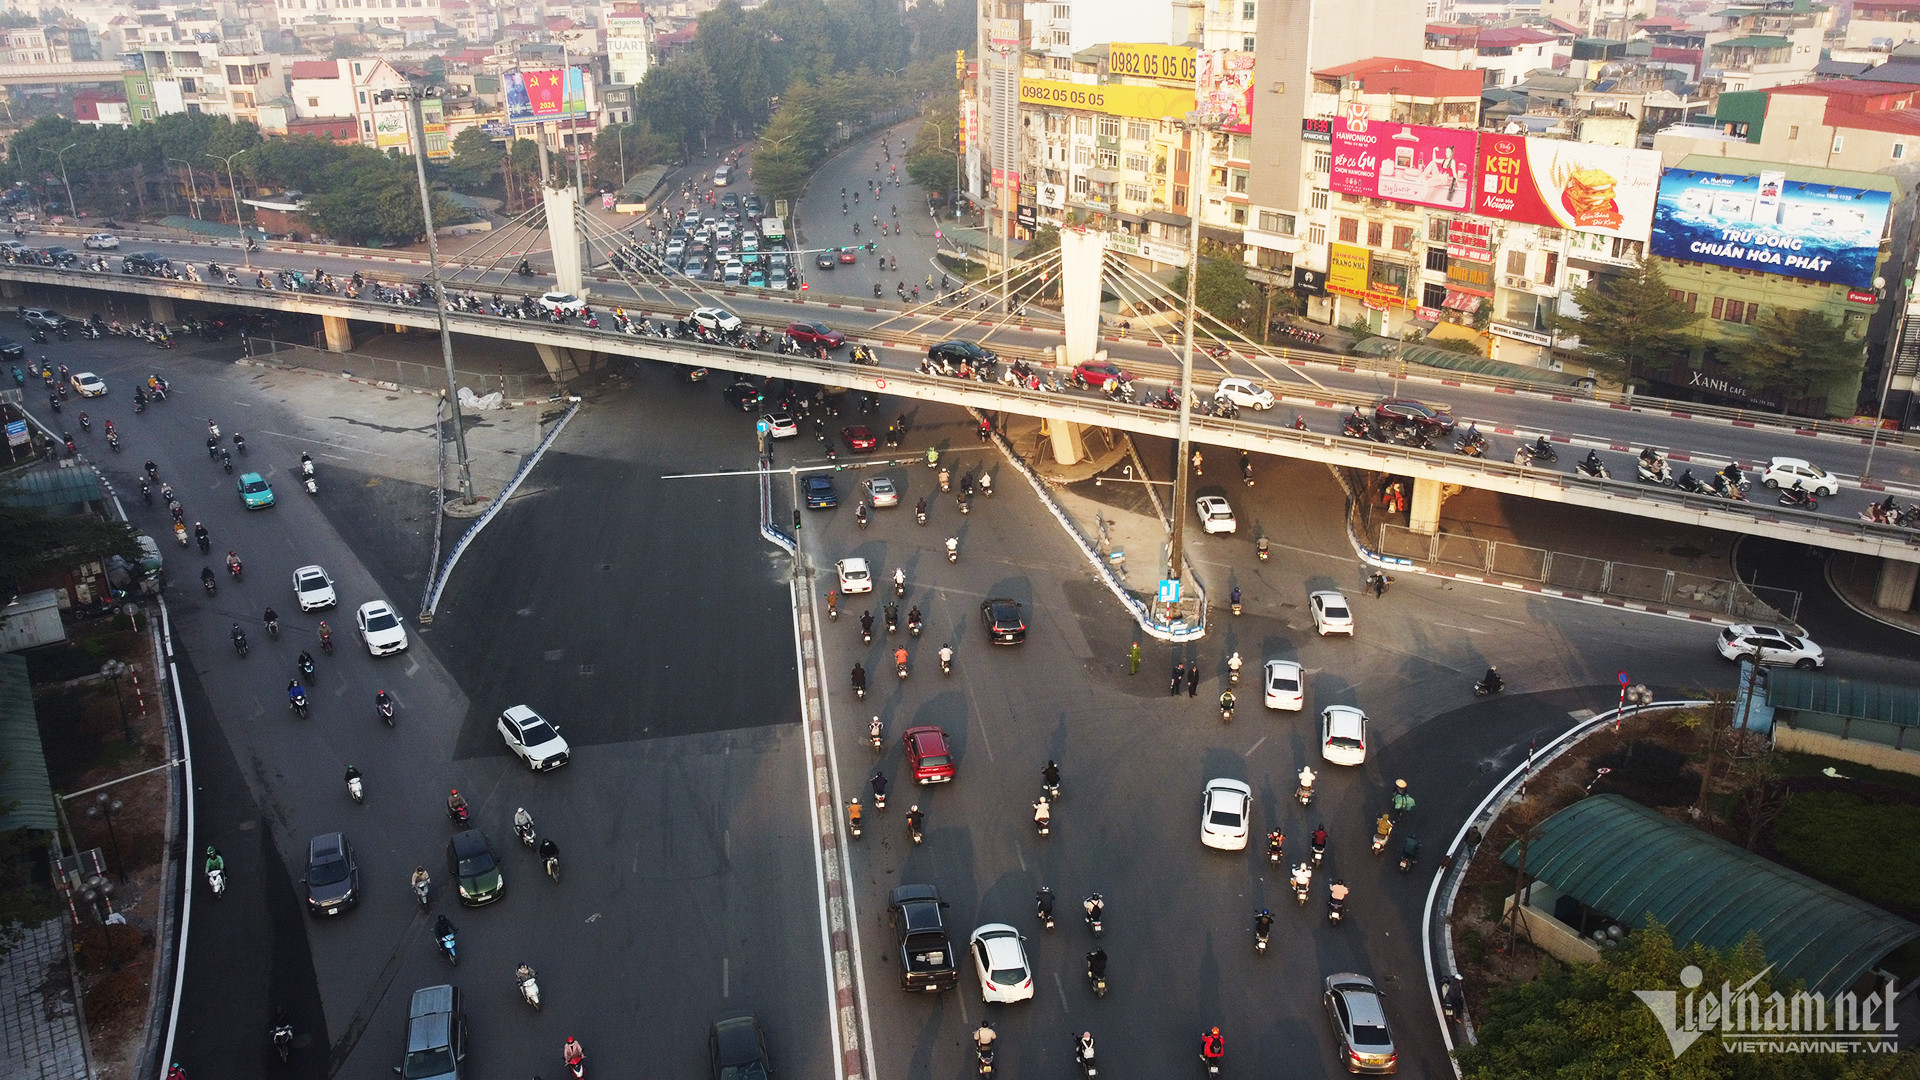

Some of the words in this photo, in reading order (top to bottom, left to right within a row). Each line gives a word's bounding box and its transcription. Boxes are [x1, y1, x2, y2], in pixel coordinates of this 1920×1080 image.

[608, 41, 644, 50] TUART
[1111, 52, 1140, 73] 0982
[1144, 54, 1158, 75] 05
[1162, 55, 1177, 77] 05
[1181, 57, 1196, 79] 05
[1022, 86, 1050, 100] 0982
[1052, 89, 1068, 102] 05
[1070, 91, 1085, 104] 05
[1088, 93, 1104, 106] 05
[1336, 132, 1377, 143] HAWONKOO
[1348, 169, 1374, 177] HAWONKOO
[1486, 155, 1520, 175] KEN
[1498, 176, 1518, 194] JU
[1483, 195, 1515, 212] Nougat
[1332, 257, 1351, 267] TRANG
[1746, 247, 1781, 265] HÒA
[1784, 255, 1832, 272] PHÁT
[1688, 371, 1728, 392] XANH
